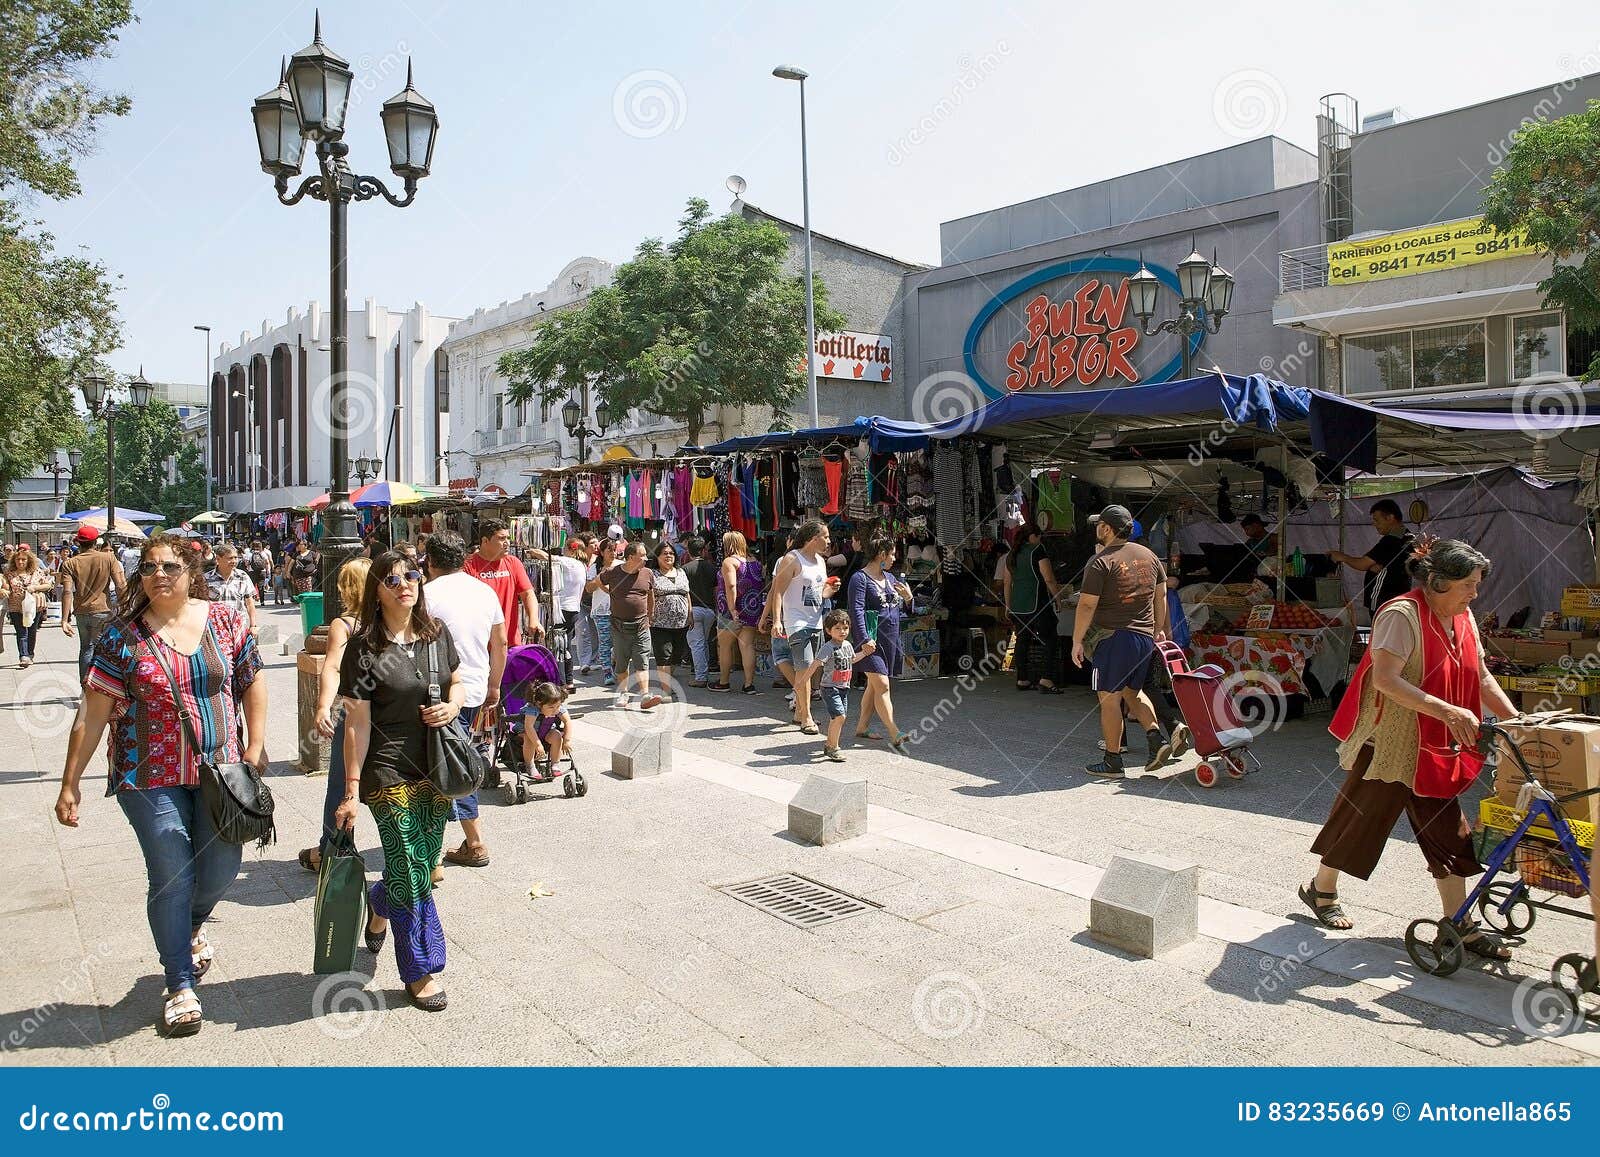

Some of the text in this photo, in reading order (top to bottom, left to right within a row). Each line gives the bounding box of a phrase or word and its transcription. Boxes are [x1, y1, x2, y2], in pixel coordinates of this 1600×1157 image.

[1332, 243, 1391, 261] ARRIENDO
[1395, 232, 1451, 251] LOCALES
[1454, 225, 1492, 241] desde
[1332, 266, 1361, 279] Cel.
[1368, 256, 1409, 275] 9841
[1415, 247, 1456, 267] 7451
[1475, 235, 1520, 256] 9841
[1024, 276, 1130, 348] BUEN
[1005, 327, 1142, 391] SABOR
